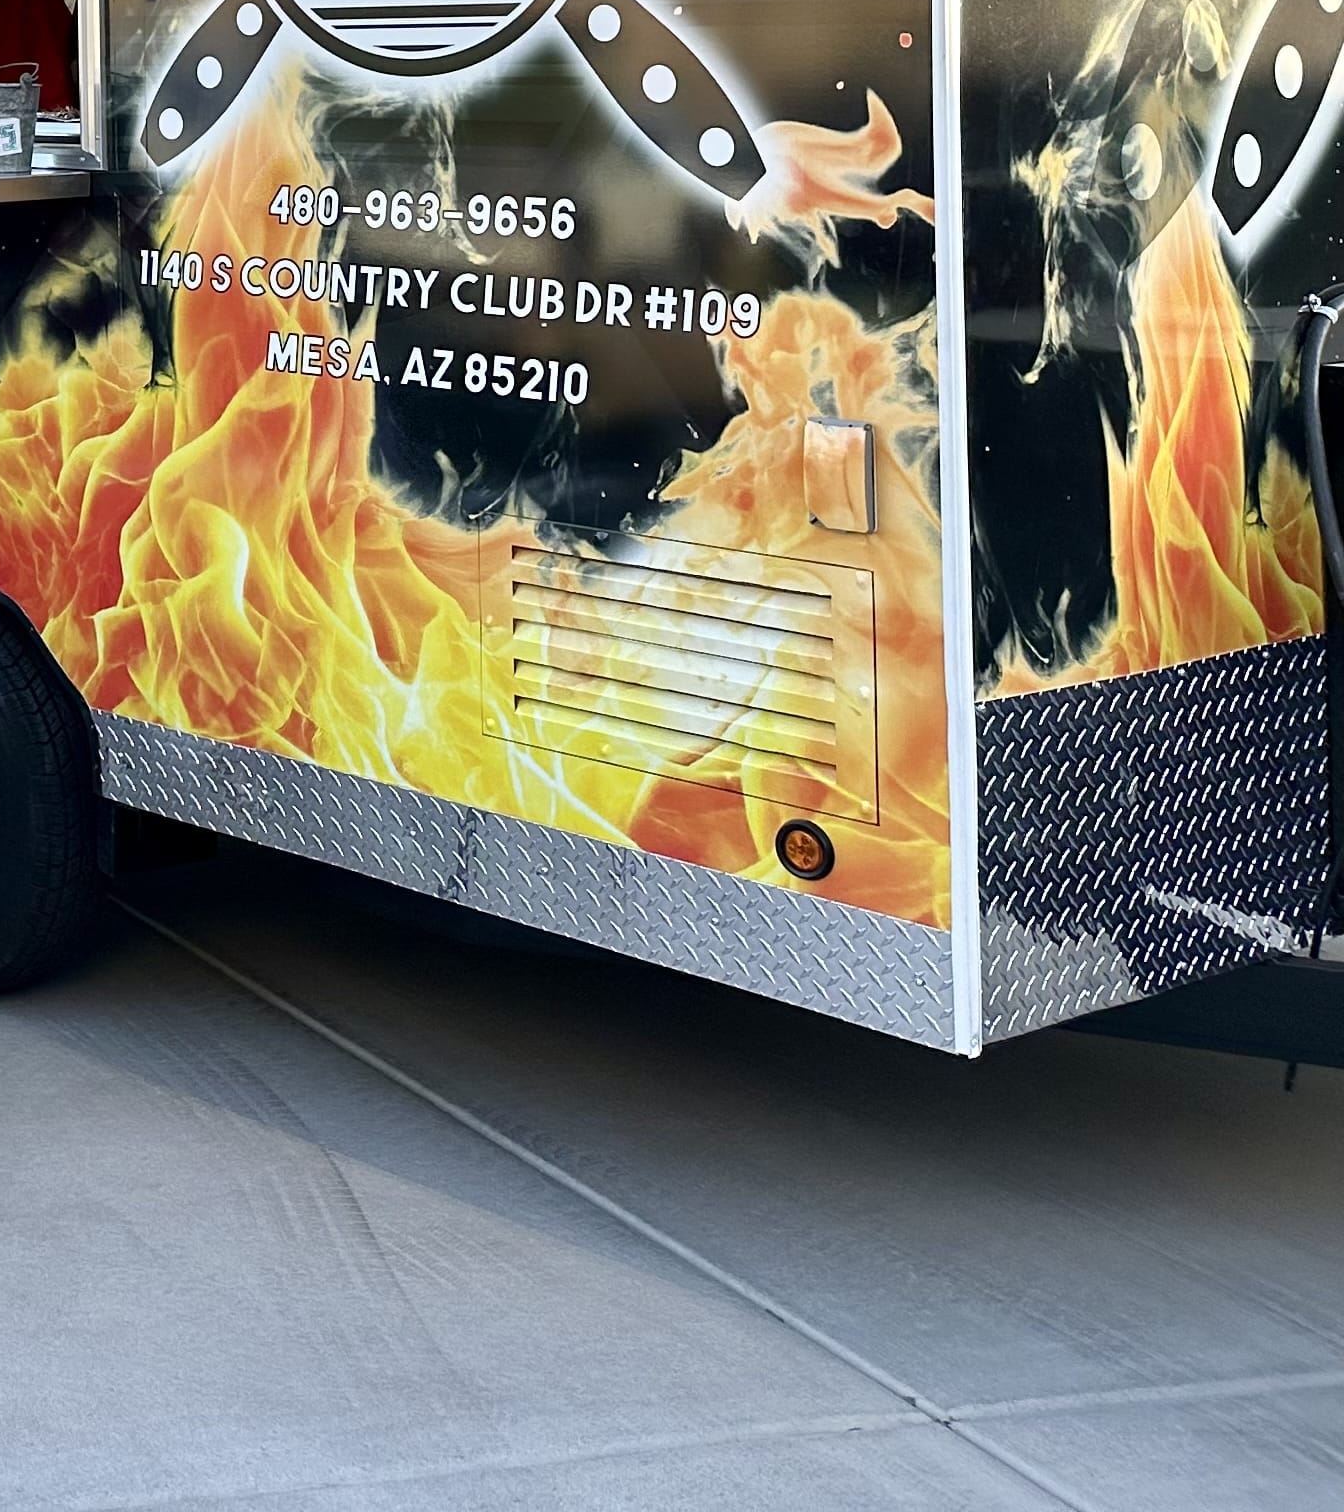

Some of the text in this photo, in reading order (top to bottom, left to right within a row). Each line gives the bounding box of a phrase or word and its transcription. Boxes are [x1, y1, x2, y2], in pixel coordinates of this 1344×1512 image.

[269, 185, 577, 240] 480-963-9656
[140, 249, 762, 339] 1140 S COUNTRY CLUB DR #109
[400, 346, 455, 391] AZ
[464, 352, 589, 406] 85210
